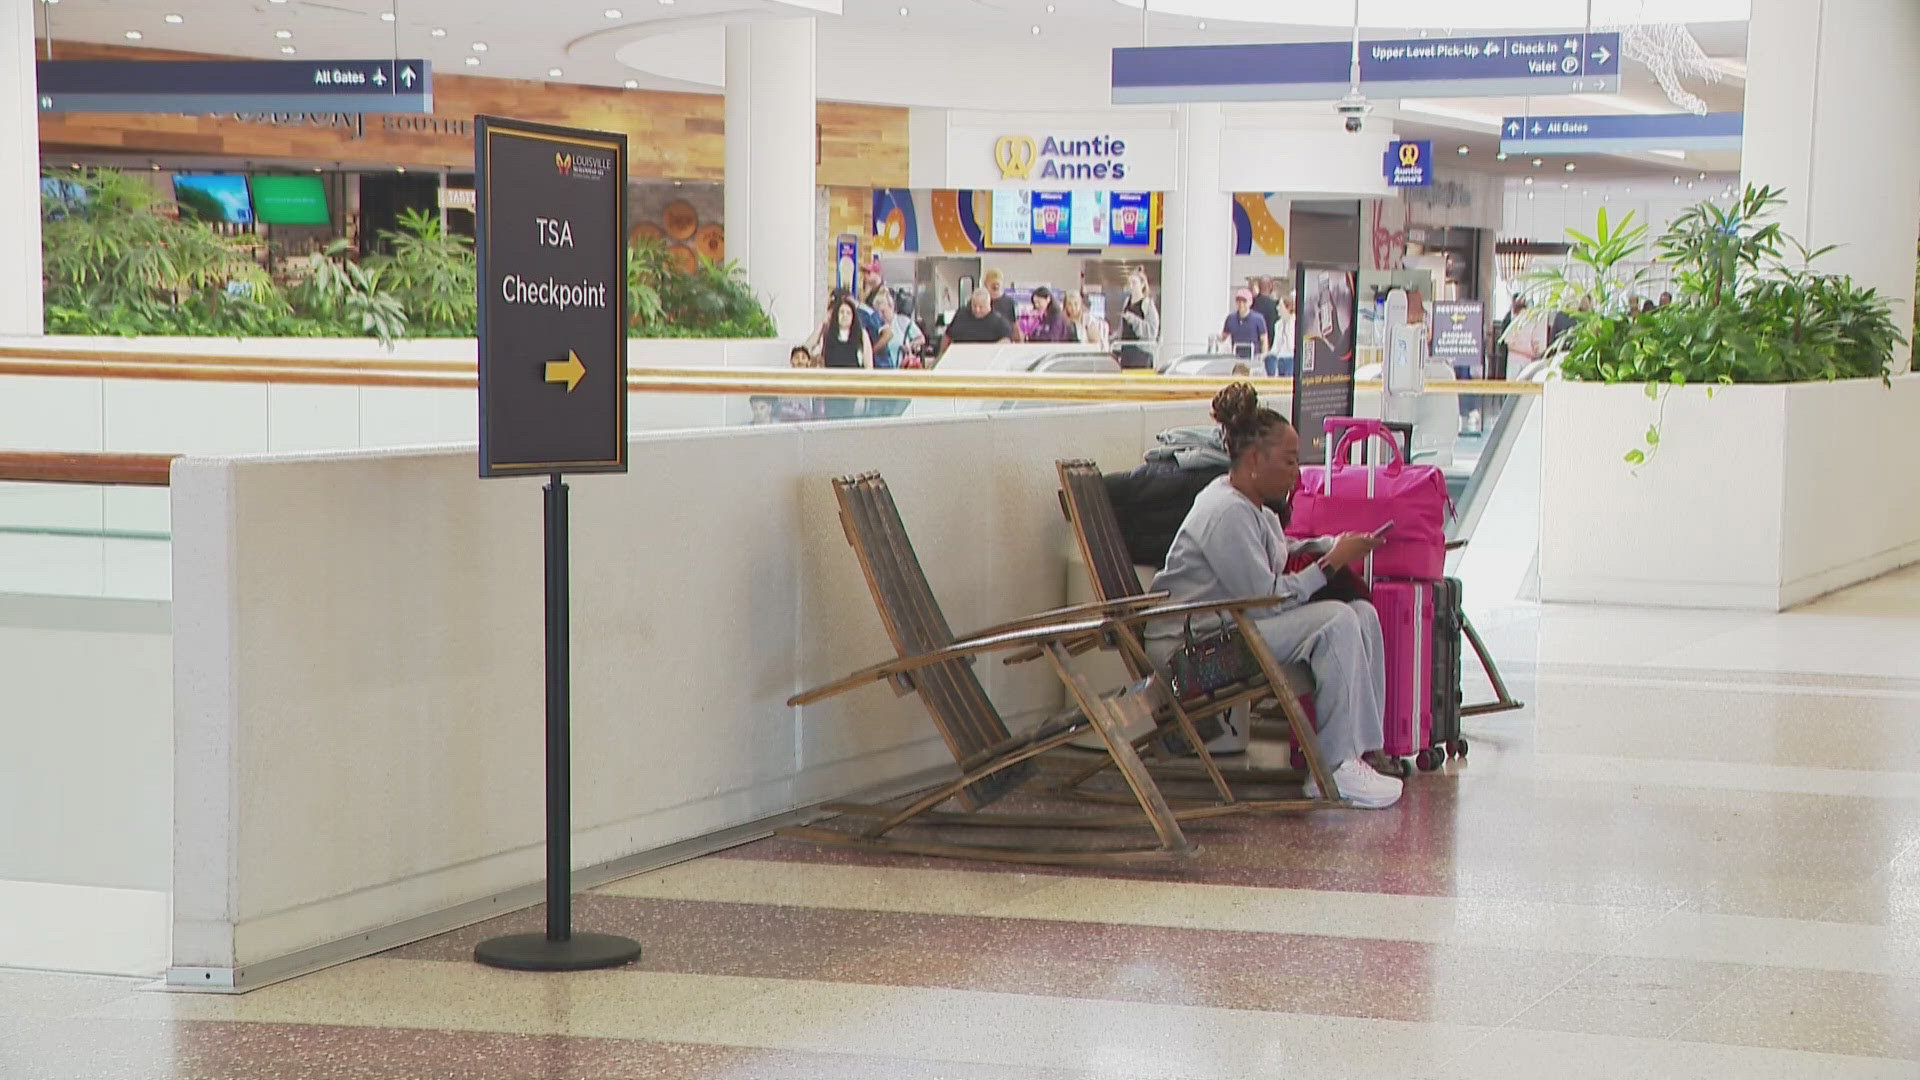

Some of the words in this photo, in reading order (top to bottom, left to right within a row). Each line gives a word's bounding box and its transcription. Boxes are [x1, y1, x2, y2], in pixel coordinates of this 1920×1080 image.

[1372, 46, 1404, 61] Upper
[1407, 45, 1436, 58] Level
[1437, 44, 1479, 60] Pick-Up
[1511, 43, 1544, 56] Check
[1546, 43, 1558, 54] In
[1528, 59, 1557, 73] Valet
[314, 70, 331, 84] All
[333, 70, 365, 84] Gates
[1547, 123, 1561, 133] All
[1562, 122, 1589, 133] Gates
[1041, 134, 1126, 156] Auntie
[573, 154, 612, 169] LOUISVILLE
[1041, 159, 1125, 179] Anne's
[1394, 166, 1423, 176] Auntie
[1394, 175, 1423, 184] Anne's
[536, 217, 574, 248] TSA
[502, 274, 606, 312] Checkpoint
[1436, 304, 1480, 314] RESTROOMS
